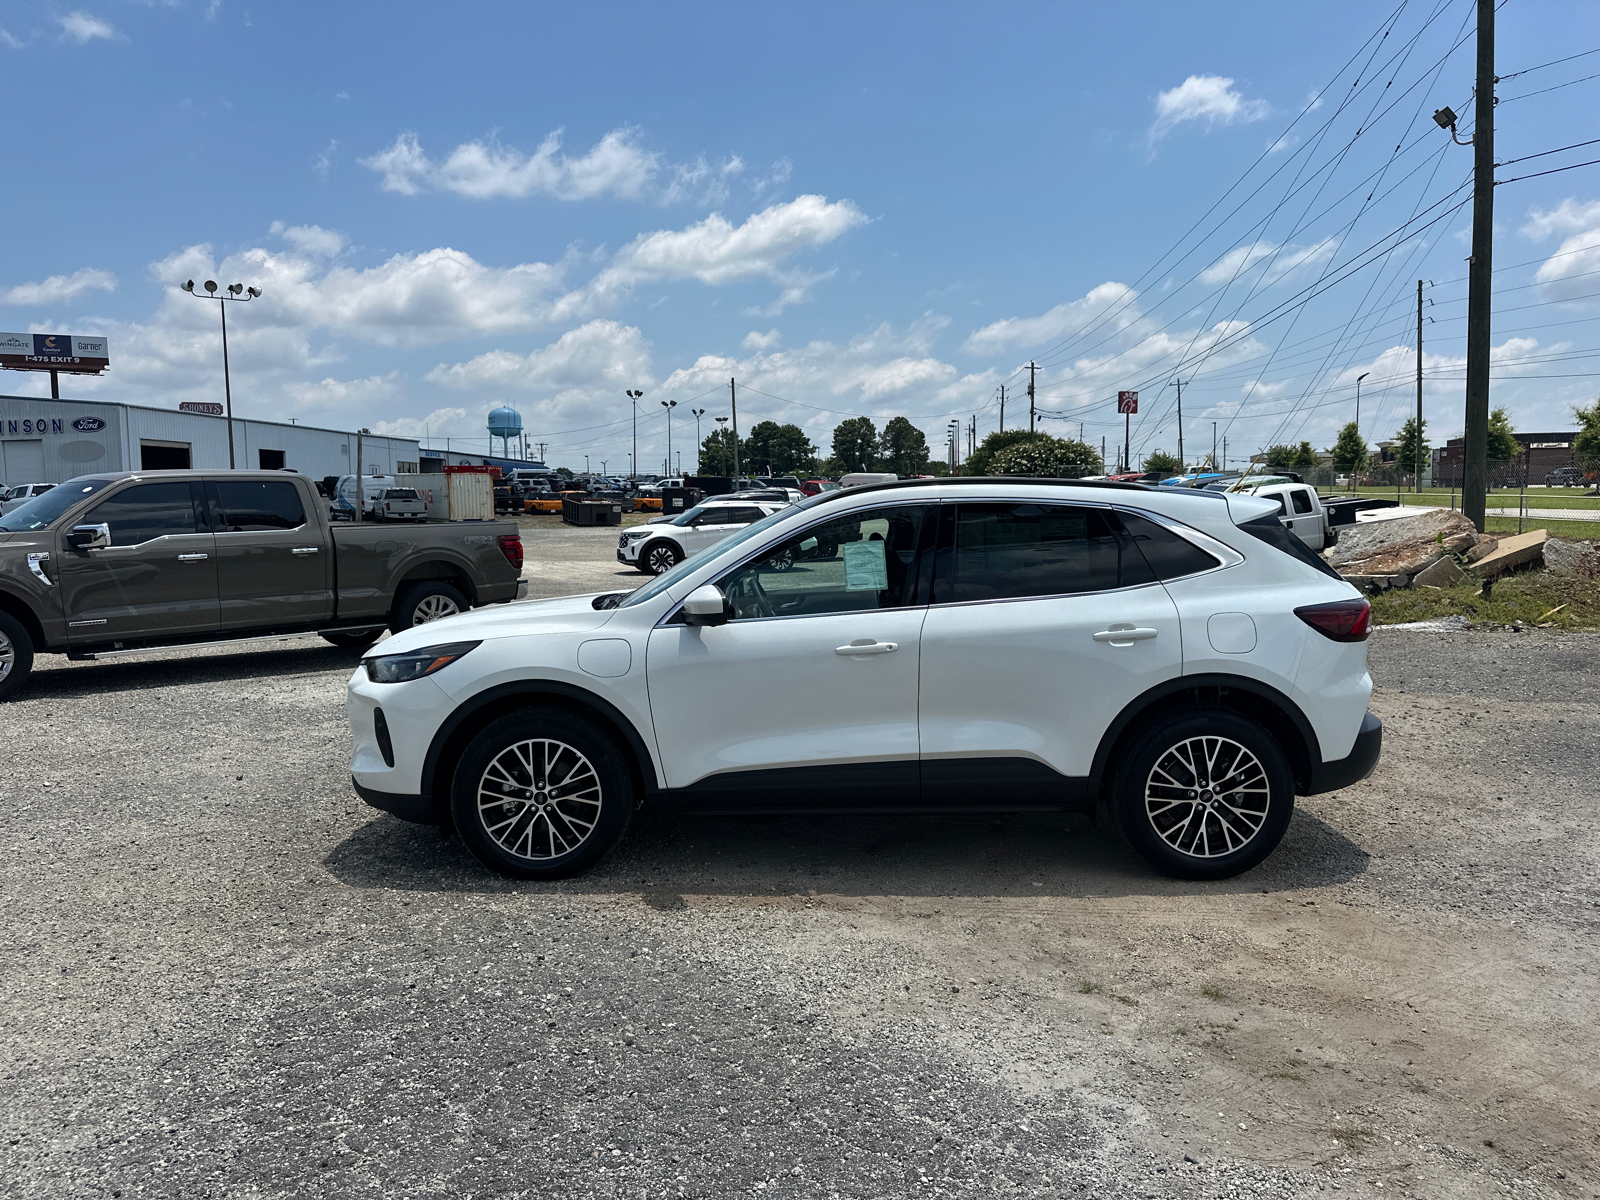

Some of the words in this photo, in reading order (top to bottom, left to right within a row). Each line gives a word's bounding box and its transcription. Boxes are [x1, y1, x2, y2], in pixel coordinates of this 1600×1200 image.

[78, 342, 102, 350] Garner
[183, 403, 221, 415] SHONEY'S
[0, 418, 63, 435] NSON
[78, 419, 99, 430] Ford
